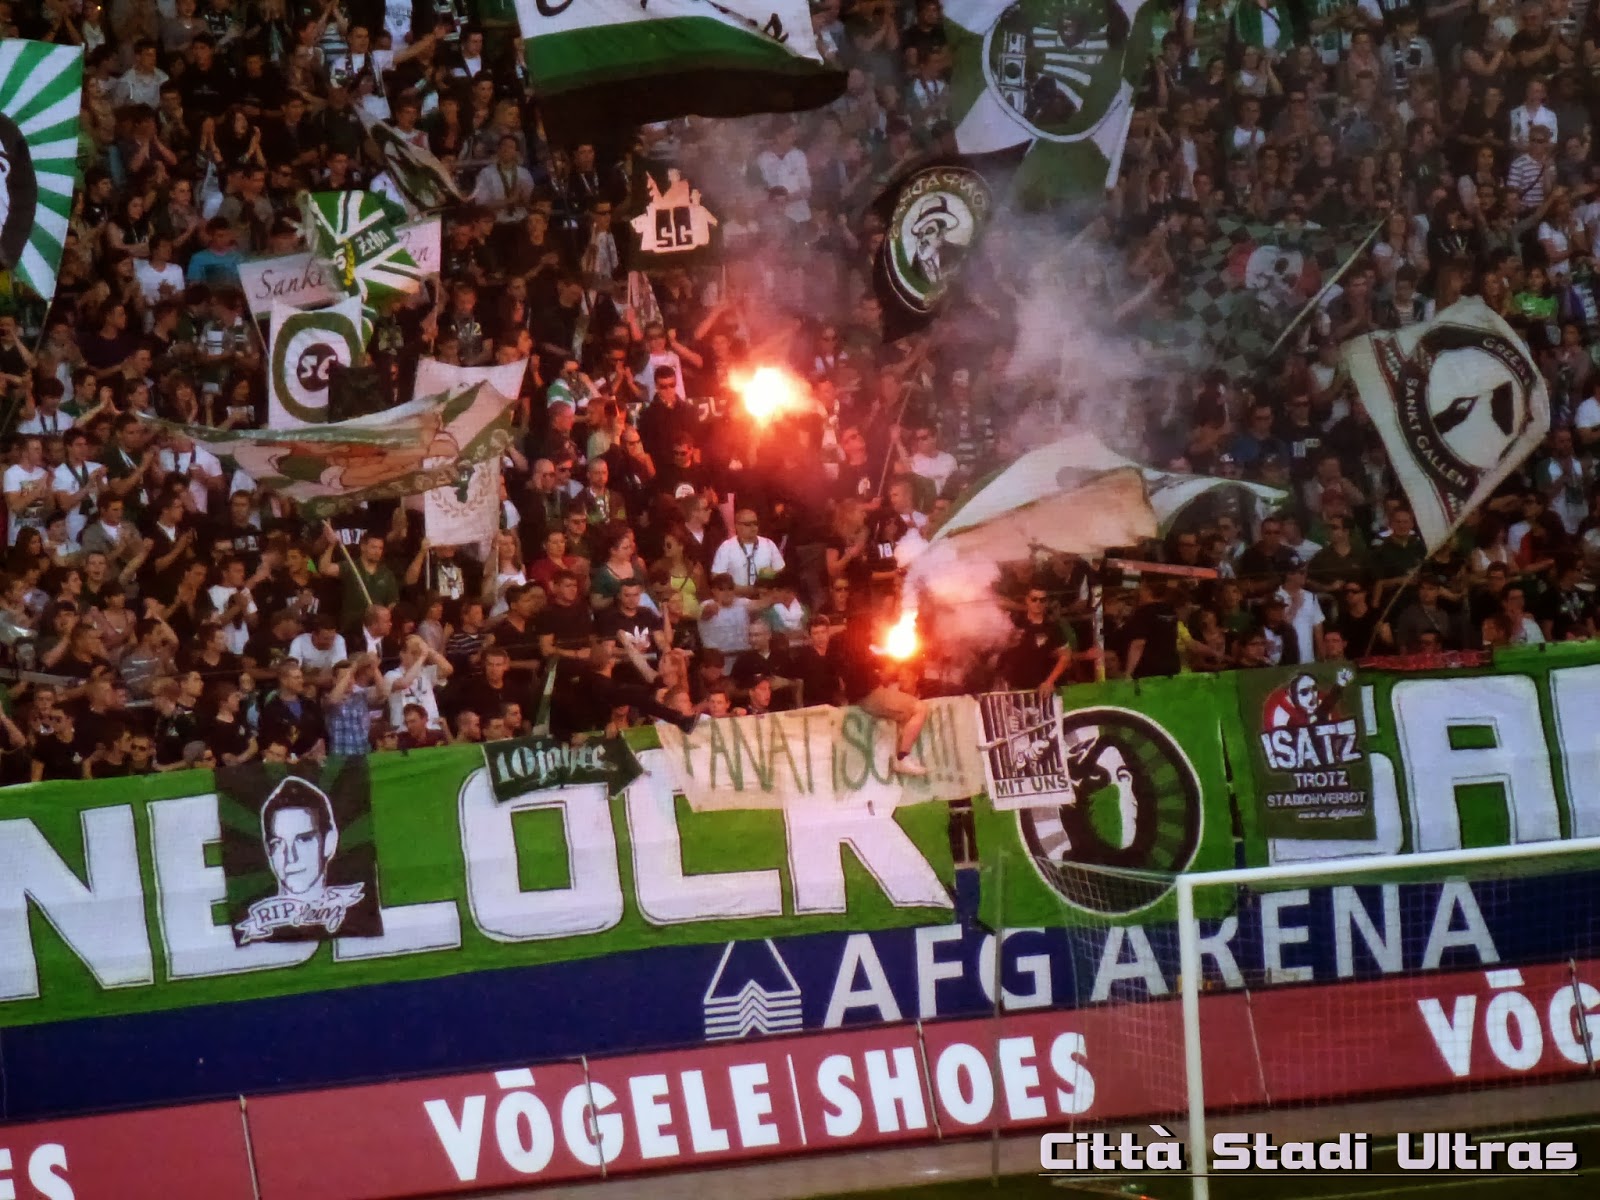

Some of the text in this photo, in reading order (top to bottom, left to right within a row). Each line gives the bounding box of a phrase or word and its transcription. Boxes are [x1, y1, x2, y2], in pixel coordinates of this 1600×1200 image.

[1416, 436, 1469, 487] GALLEN
[995, 775, 1068, 796] MIT UNS
[1294, 771, 1349, 788] TROTZ
[1267, 792, 1366, 807] STADIONVERBOT
[257, 902, 295, 923] RIP
[823, 924, 1052, 1028] AFG
[818, 1032, 1095, 1137] SHOES
